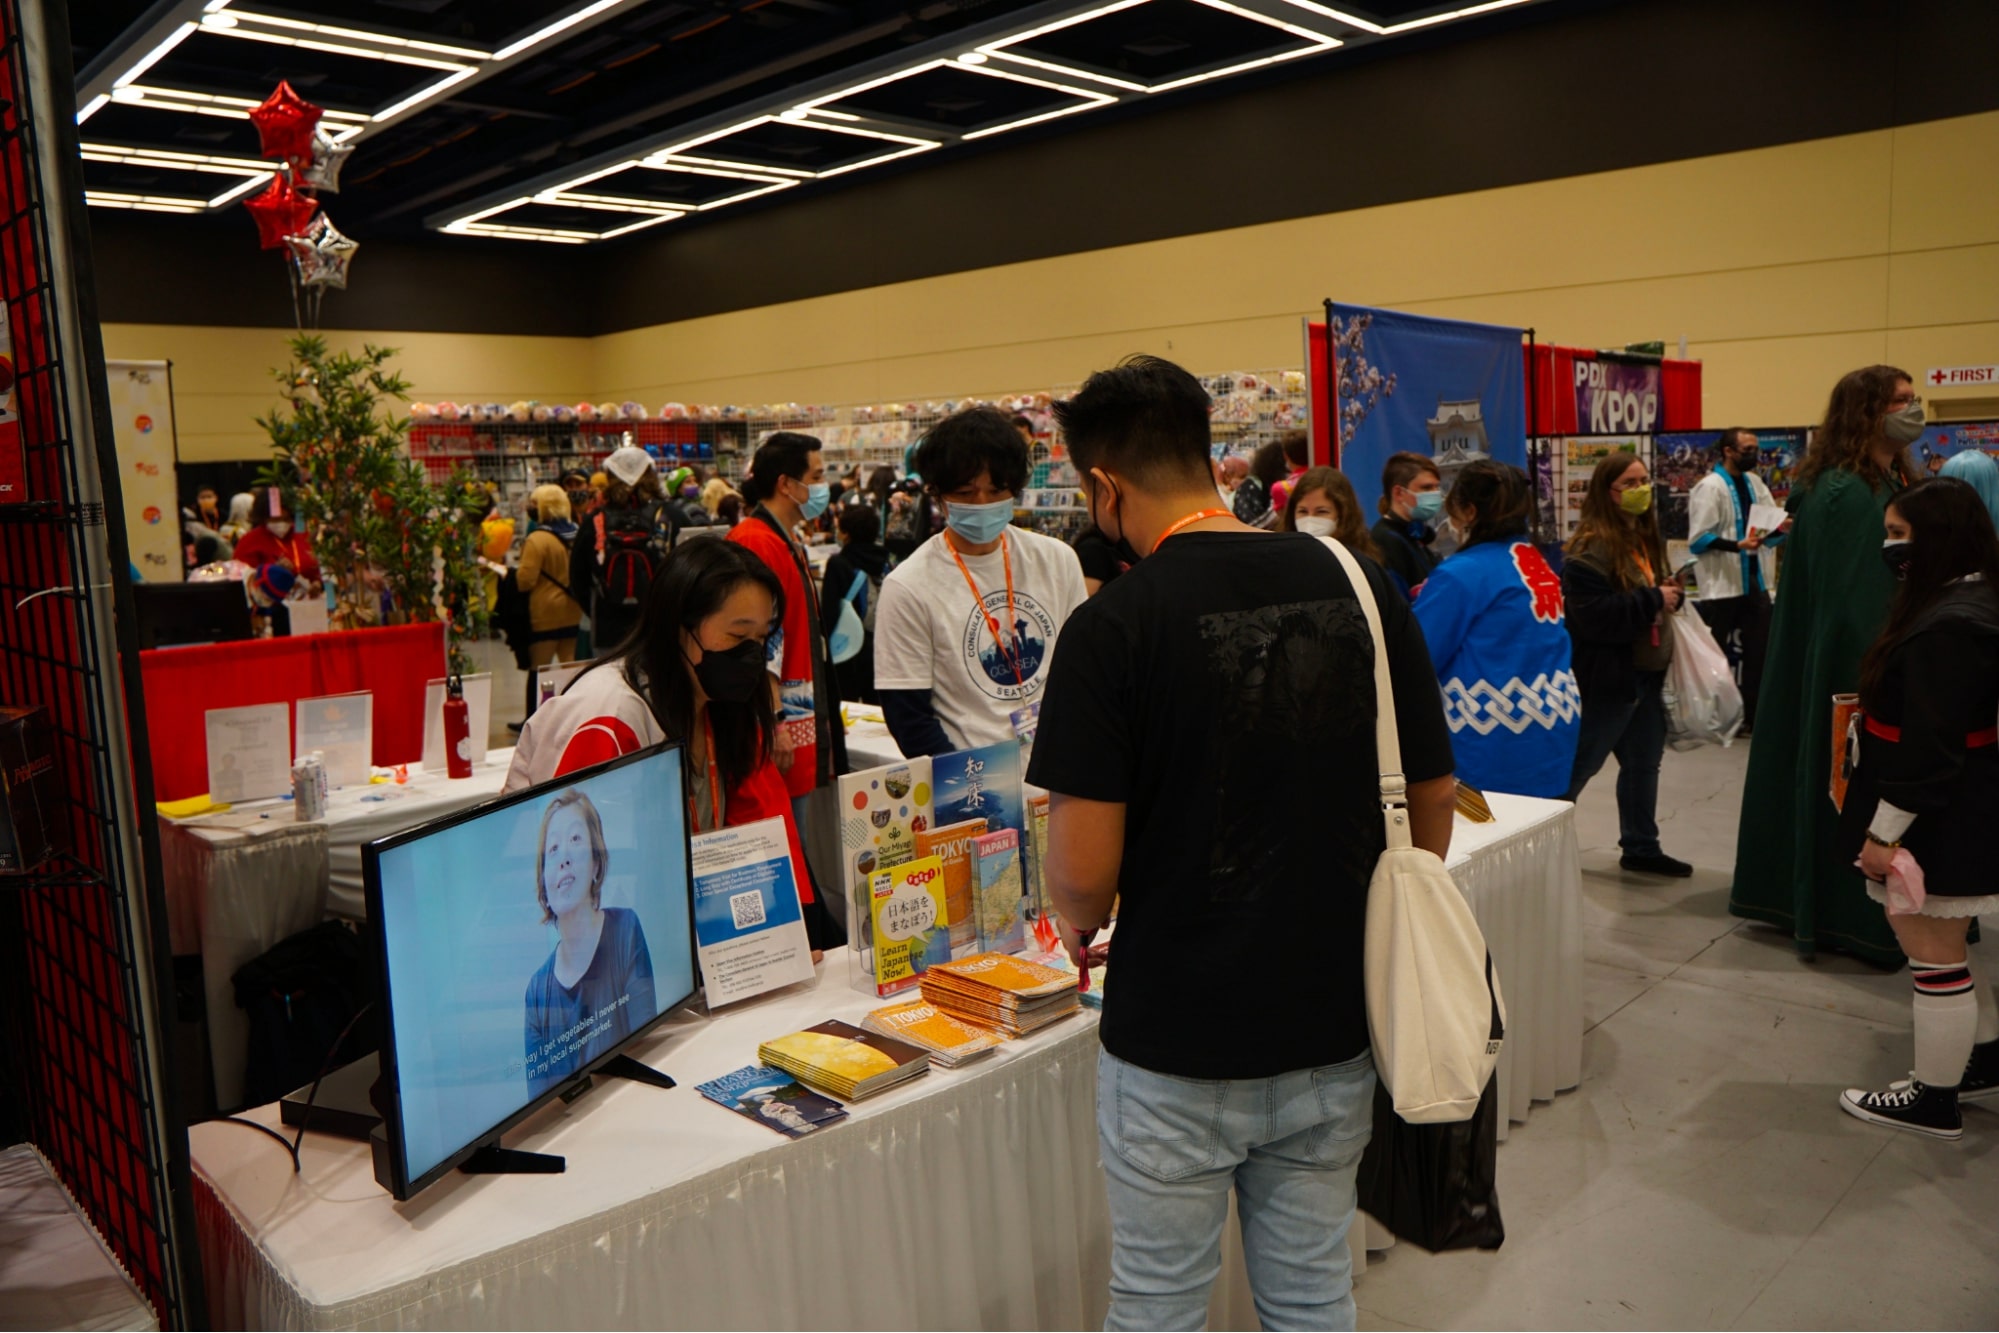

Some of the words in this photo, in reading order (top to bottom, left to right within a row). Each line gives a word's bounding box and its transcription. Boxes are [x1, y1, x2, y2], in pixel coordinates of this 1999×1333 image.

[1575, 361, 1608, 389] PDX
[1950, 367, 1995, 383] FIRST
[1591, 389, 1658, 434] KPOP
[968, 610, 984, 658] CONSULAT
[1024, 600, 1035, 610] OF
[1034, 610, 1053, 637] JAPAN
[964, 756, 985, 807] 知床
[930, 836, 971, 860] TOKYO
[980, 838, 1009, 857] JAPAN
[874, 878, 890, 886] NHK
[888, 896, 929, 918] 日本語を
[881, 944, 908, 957] Learn
[882, 950, 924, 969] Japanese
[883, 964, 906, 980] Now!
[544, 1039, 556, 1056] get
[557, 1014, 594, 1044] vegetables
[598, 1002, 617, 1018] never
[618, 994, 630, 1006] see
[892, 1006, 934, 1024] TOKYO
[528, 1068, 536, 1080] in
[537, 1061, 549, 1074] my
[550, 1050, 568, 1066] local
[568, 1019, 612, 1052] supermarket.
